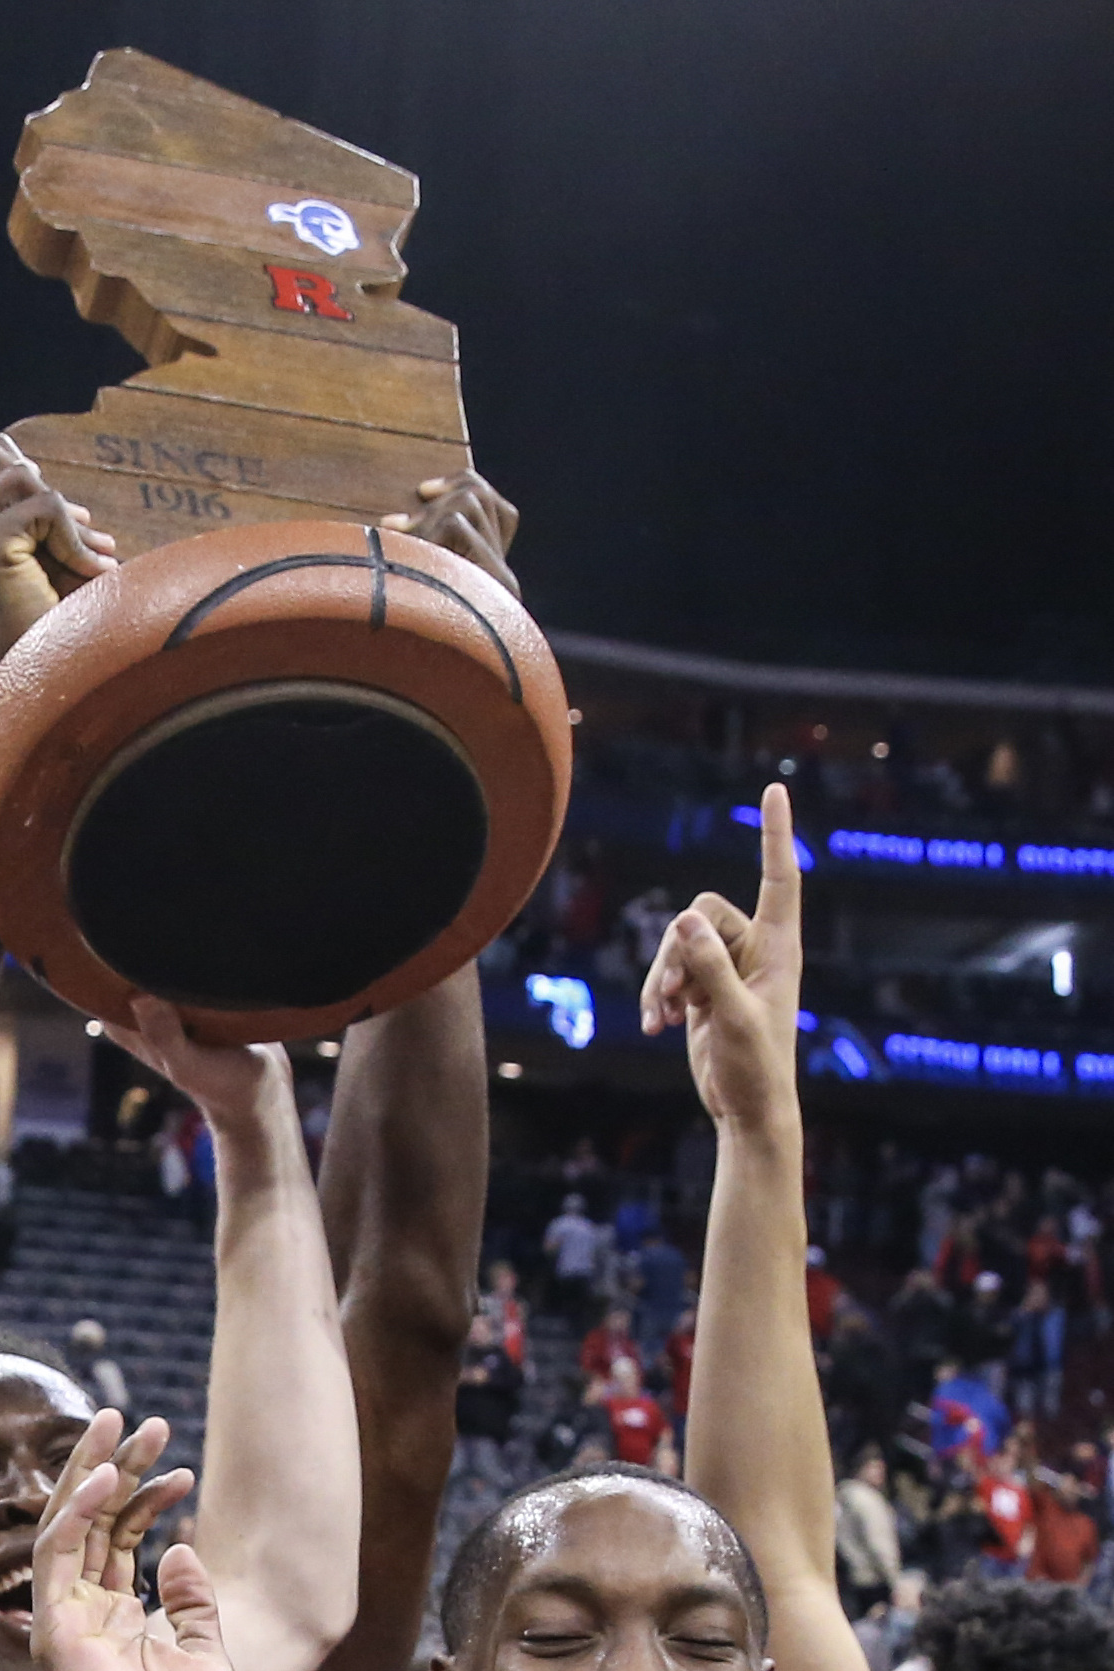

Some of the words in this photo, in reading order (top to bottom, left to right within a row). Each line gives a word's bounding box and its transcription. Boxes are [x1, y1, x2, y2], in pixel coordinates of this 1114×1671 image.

[265, 264, 354, 321] R
[95, 433, 269, 488] SINCE
[139, 482, 232, 519] 1916
